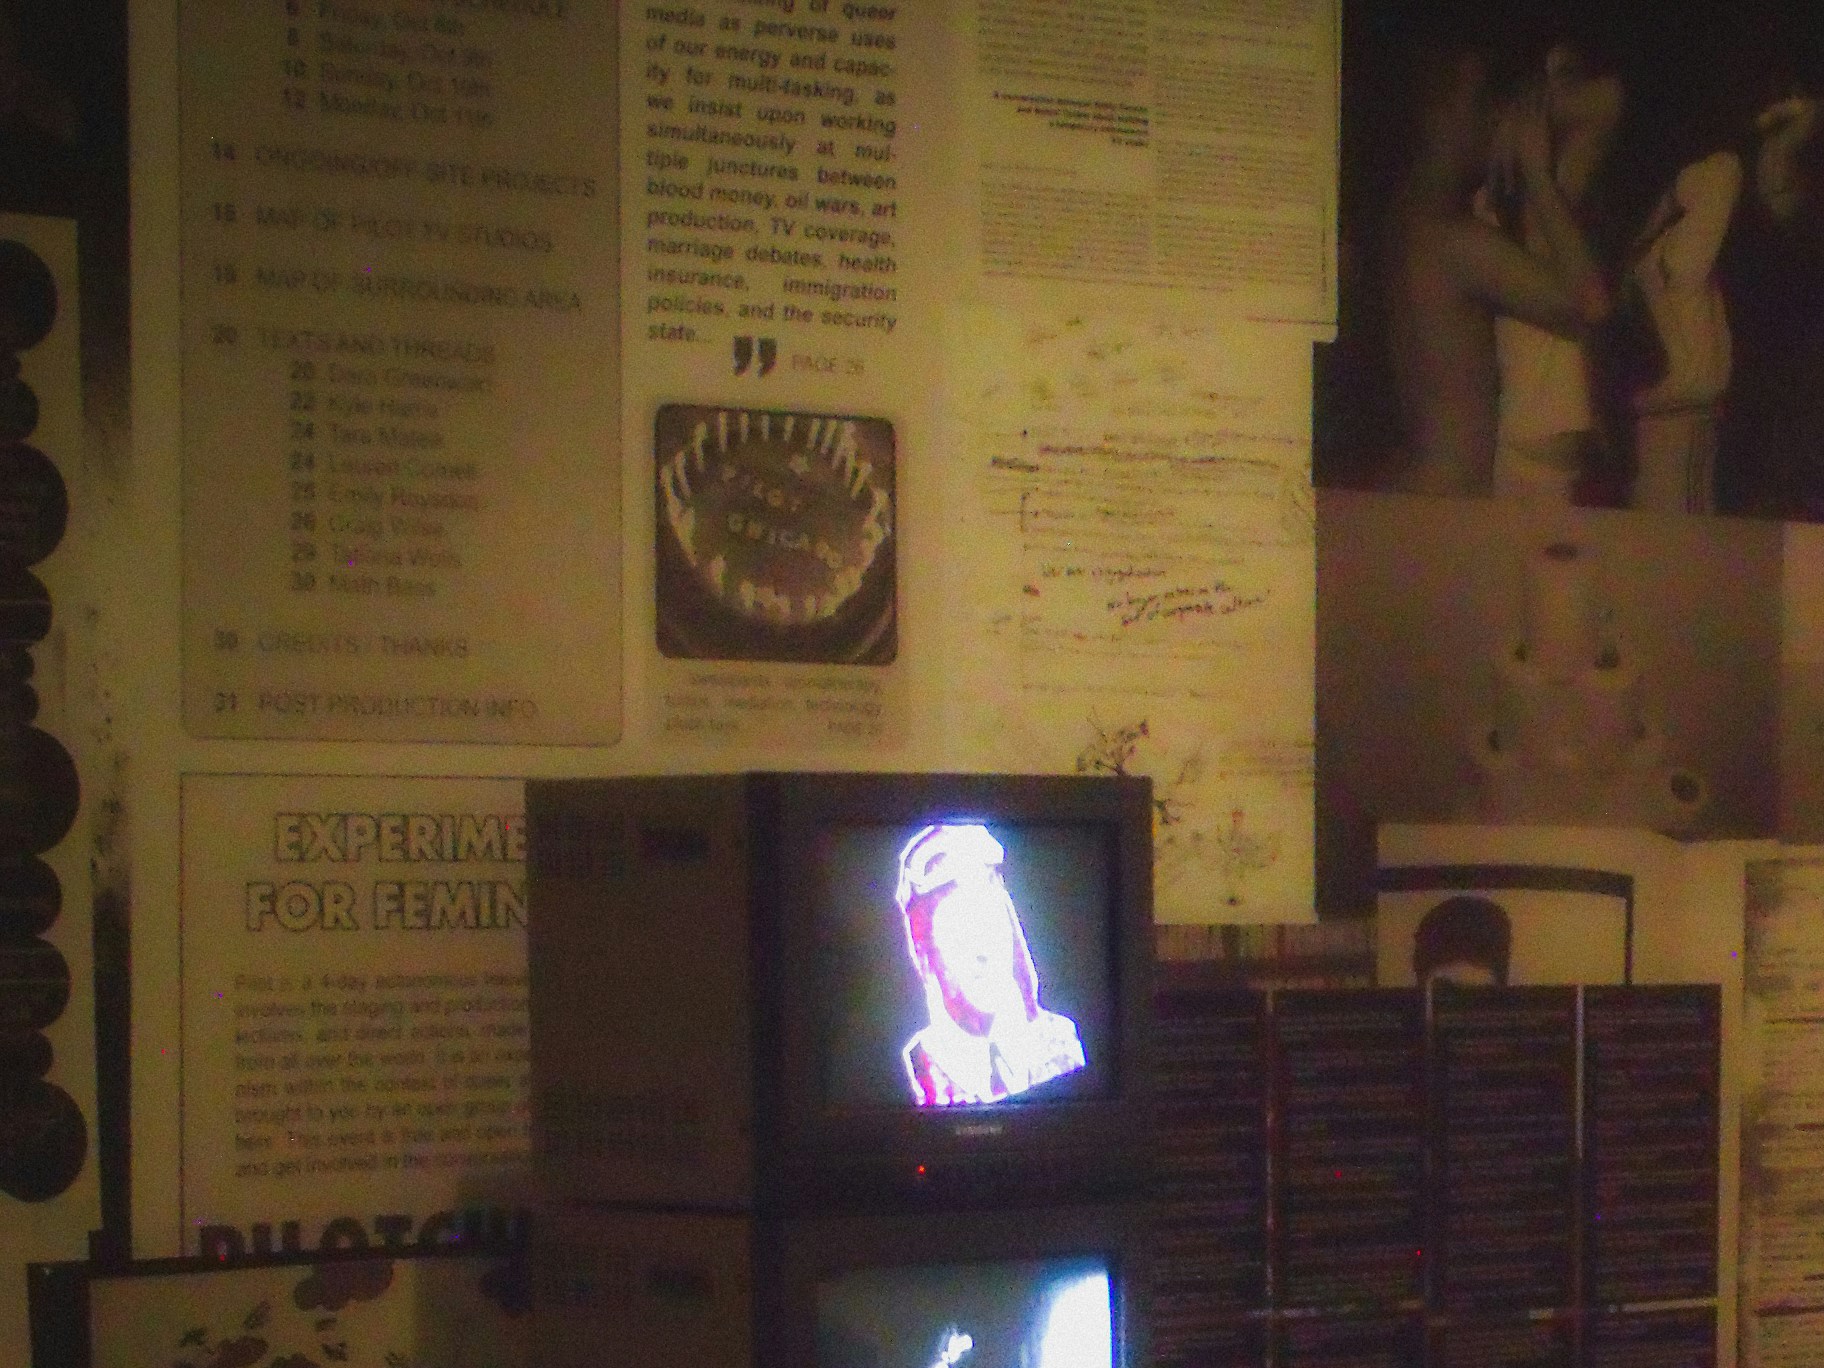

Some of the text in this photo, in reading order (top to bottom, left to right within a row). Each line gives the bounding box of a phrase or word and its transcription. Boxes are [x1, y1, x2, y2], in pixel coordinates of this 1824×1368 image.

[645, 6, 897, 50] media as perverse uses
[842, 2, 897, 21] queer
[645, 33, 667, 50] of
[673, 39, 708, 56] our
[715, 42, 782, 68] energy
[790, 51, 826, 70] and
[645, 60, 670, 85] ity
[685, 65, 713, 86] for
[874, 90, 897, 105] as
[646, 94, 897, 139] we insist upon working
[646, 123, 797, 157] simultaneously
[816, 139, 836, 158] at
[425, 162, 475, 187] SITE
[481, 167, 598, 198] PROJECTS
[646, 149, 897, 190] tiple junctures between
[646, 181, 704, 200] blood
[785, 193, 808, 211] oil
[815, 196, 866, 217] wars,
[871, 201, 898, 219] art
[256, 205, 301, 229] MAP
[312, 211, 341, 231] OF
[457, 224, 554, 254] STUDIOS
[646, 208, 897, 250] production, TV coverage,
[646, 238, 734, 265] marriage
[838, 253, 897, 273] health
[256, 265, 307, 289] MAP
[311, 272, 343, 294] OF
[352, 275, 519, 308] SURROUNDING
[523, 289, 582, 314] AREA
[647, 267, 897, 303] insurance, immigration
[738, 303, 775, 322] and
[782, 306, 814, 323] the
[820, 309, 897, 335] security
[257, 326, 331, 353] TEXTS
[335, 330, 383, 354] AND
[390, 335, 495, 366] THREADS
[380, 634, 469, 659] THANKS
[259, 692, 322, 717] POST
[328, 694, 479, 719] PRODUCTION
[246, 880, 528, 932] FOR FEMIN
